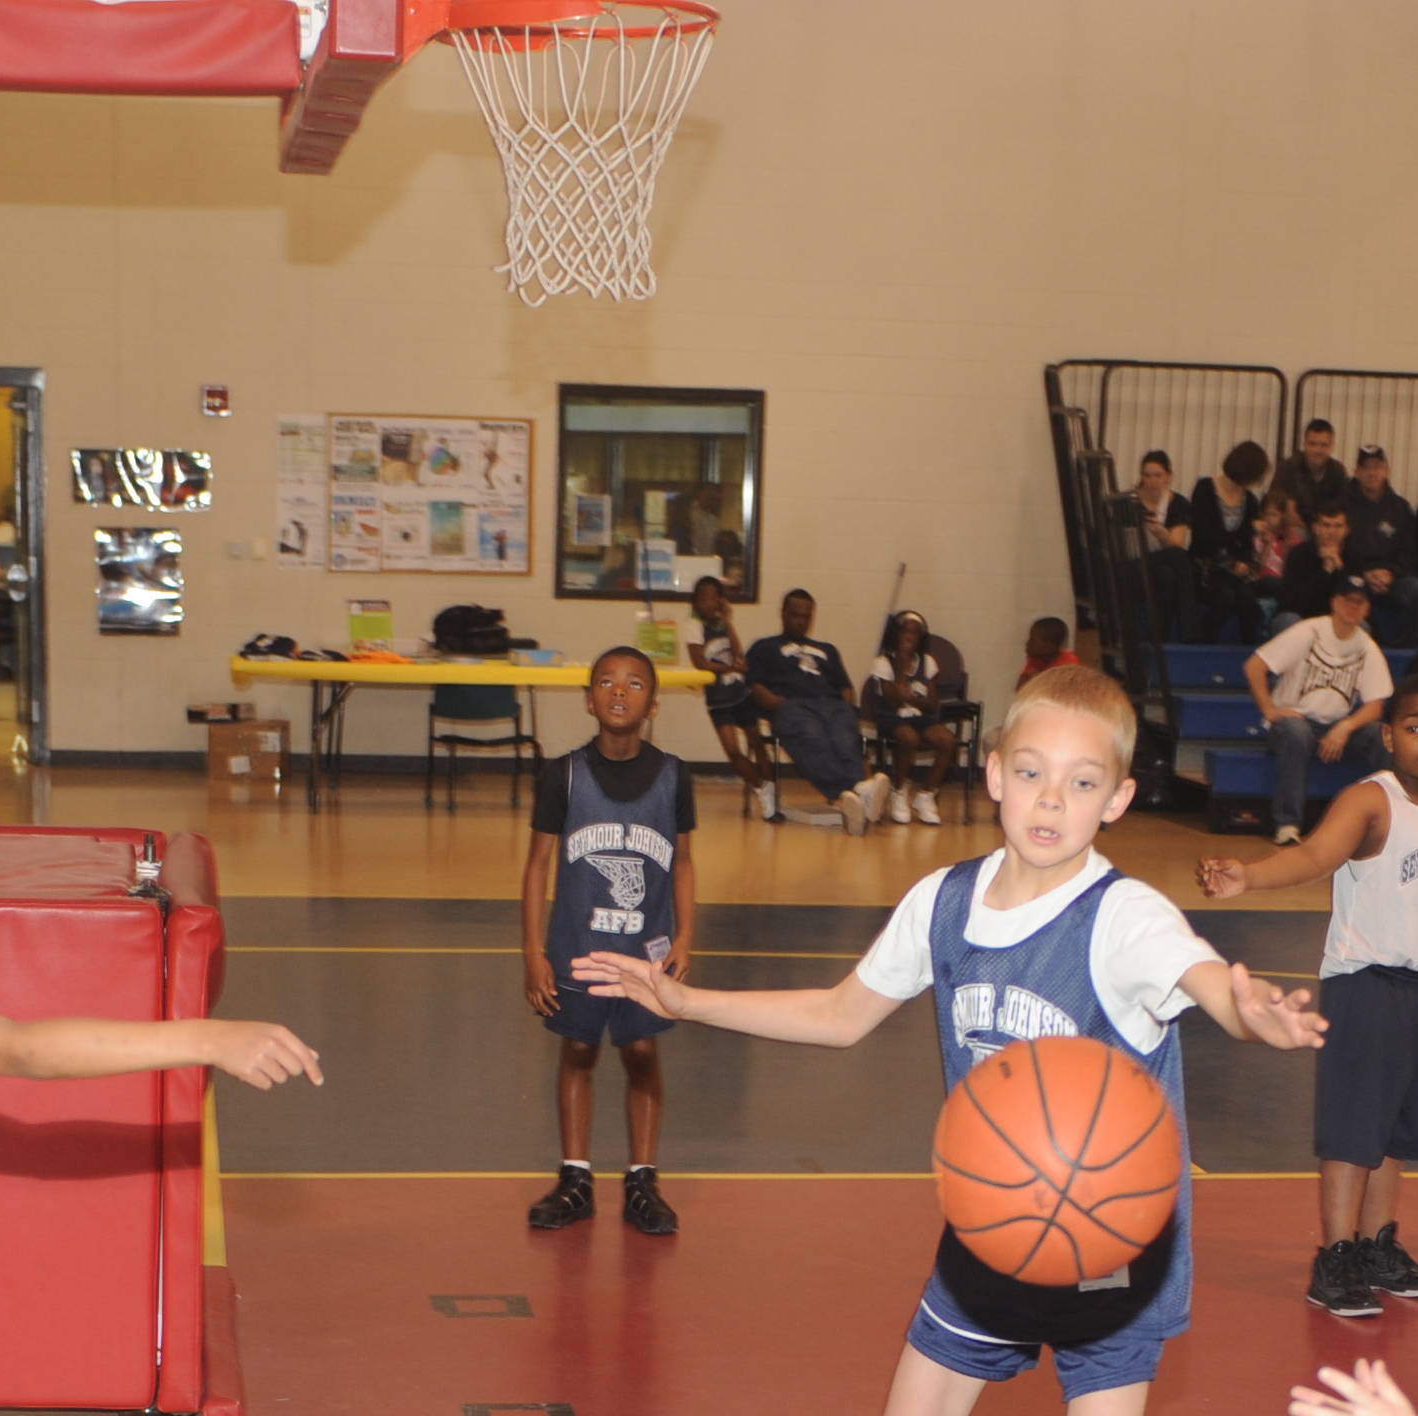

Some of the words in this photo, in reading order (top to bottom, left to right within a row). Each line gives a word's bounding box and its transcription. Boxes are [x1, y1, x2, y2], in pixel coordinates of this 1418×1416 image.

[567, 823, 624, 864] SEYMOUR
[625, 824, 674, 873] JOHNSON
[590, 907, 645, 934] AFB
